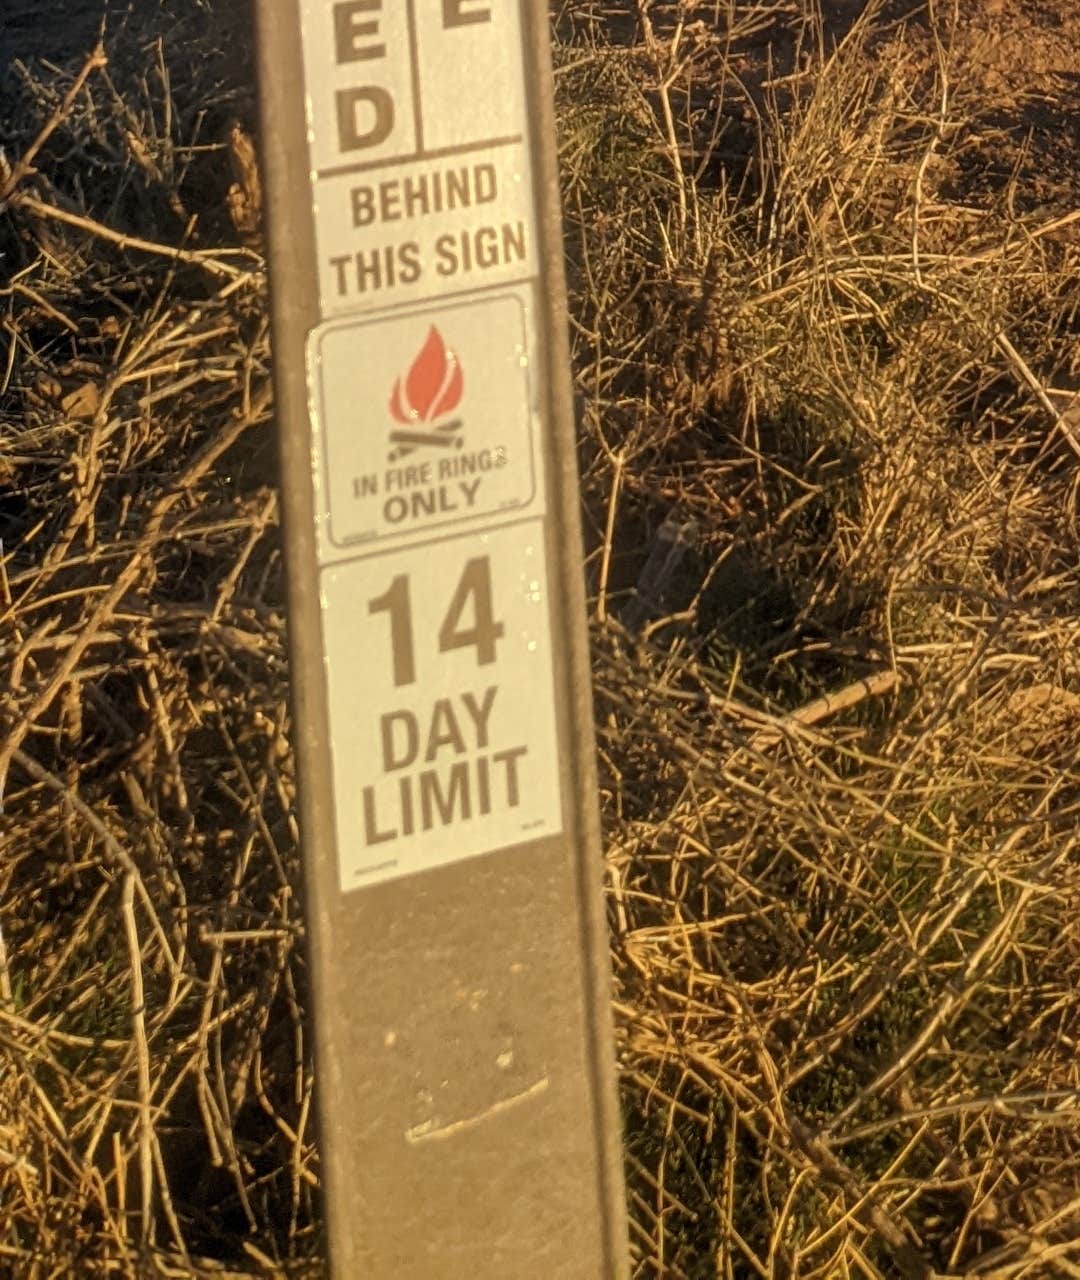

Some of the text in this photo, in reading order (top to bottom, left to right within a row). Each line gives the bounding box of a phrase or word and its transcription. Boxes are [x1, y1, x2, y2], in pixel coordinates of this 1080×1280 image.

[350, 163, 499, 228] BEHIND
[329, 221, 527, 297] THIS SIGN
[353, 474, 378, 500] IN
[385, 461, 431, 493] FIRE
[383, 478, 481, 524] ONLY
[368, 556, 504, 687] 14
[379, 686, 499, 773] DAY
[362, 747, 528, 846] LIMIT
